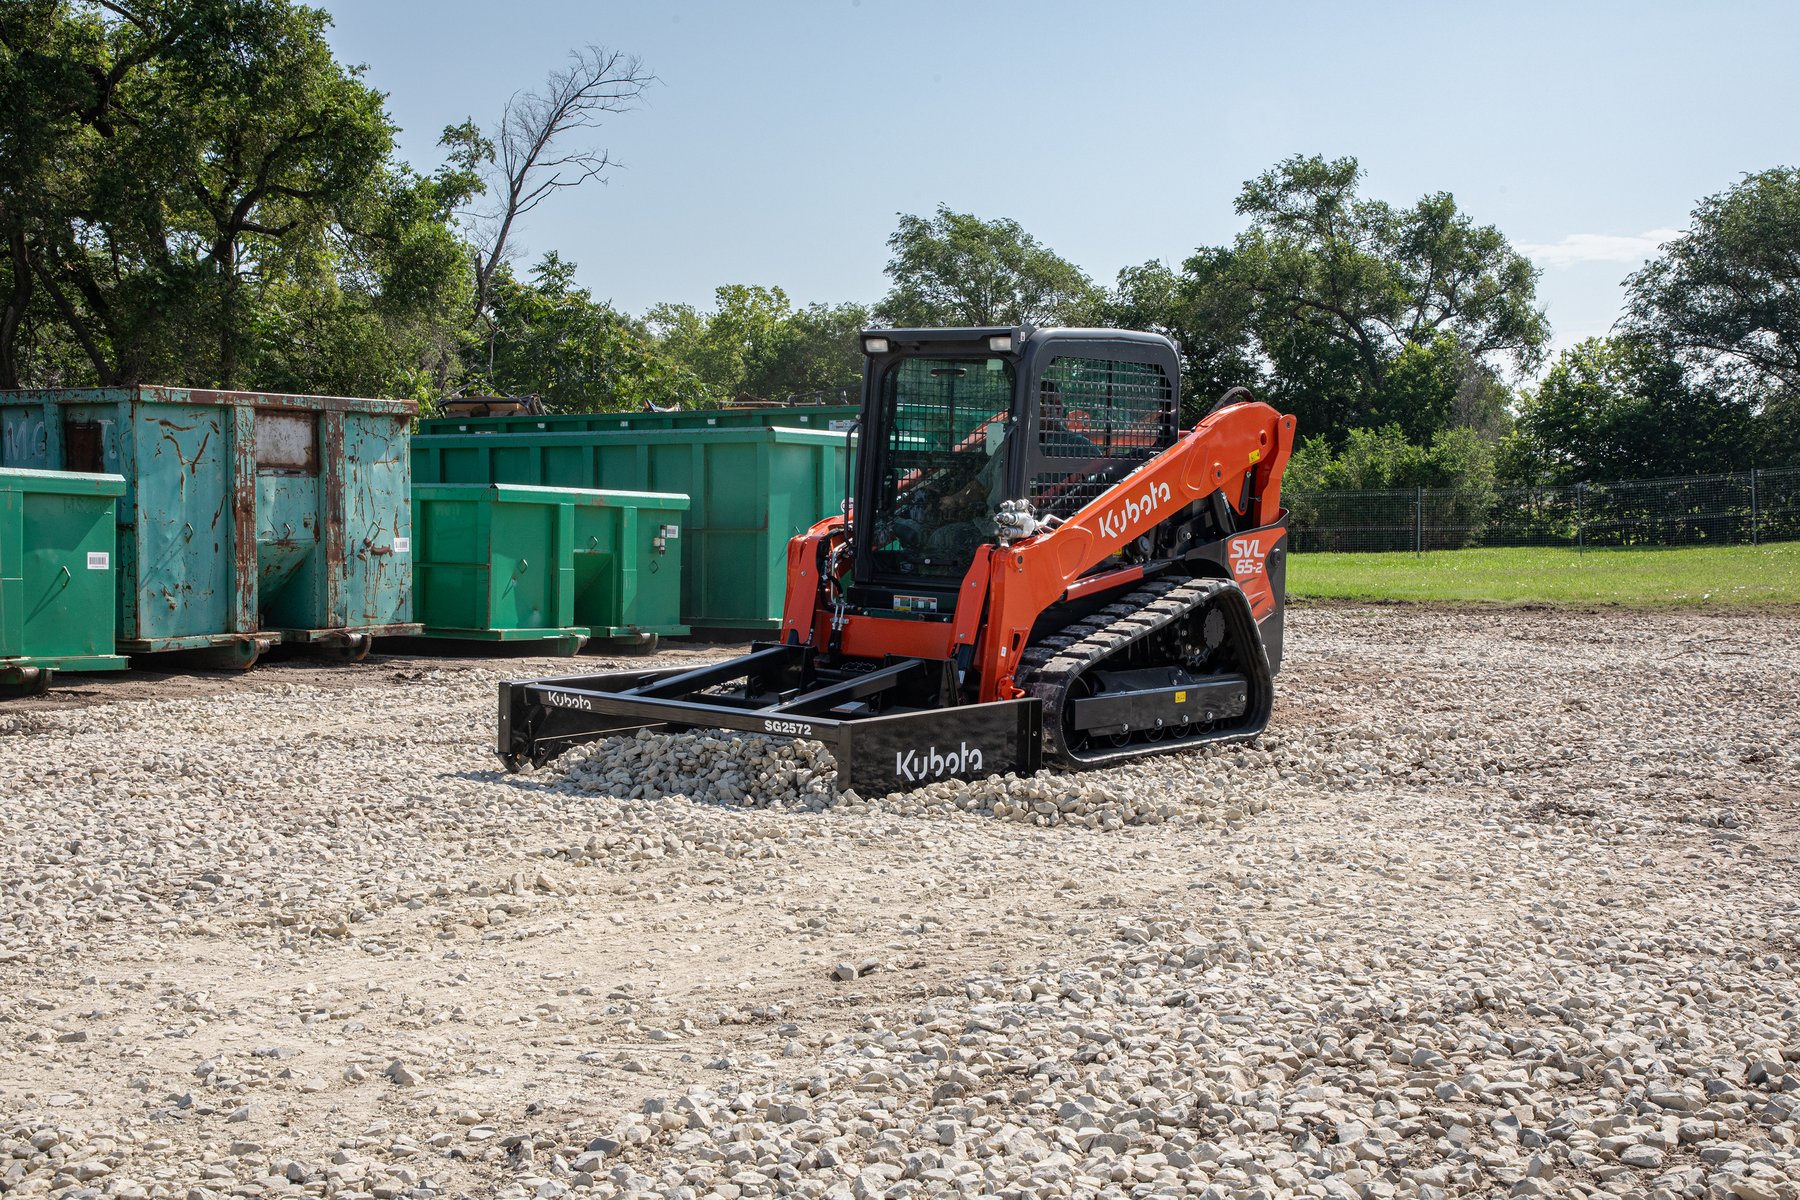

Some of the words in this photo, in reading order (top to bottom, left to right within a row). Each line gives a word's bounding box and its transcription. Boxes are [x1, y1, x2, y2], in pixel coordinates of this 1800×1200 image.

[1098, 481, 1171, 539] Kubota
[1230, 539, 1265, 558] SVL
[1235, 559, 1263, 574] 65-2
[547, 690, 592, 710] Kubota
[764, 719, 812, 736] SG2572
[896, 741, 983, 781] Kubota
